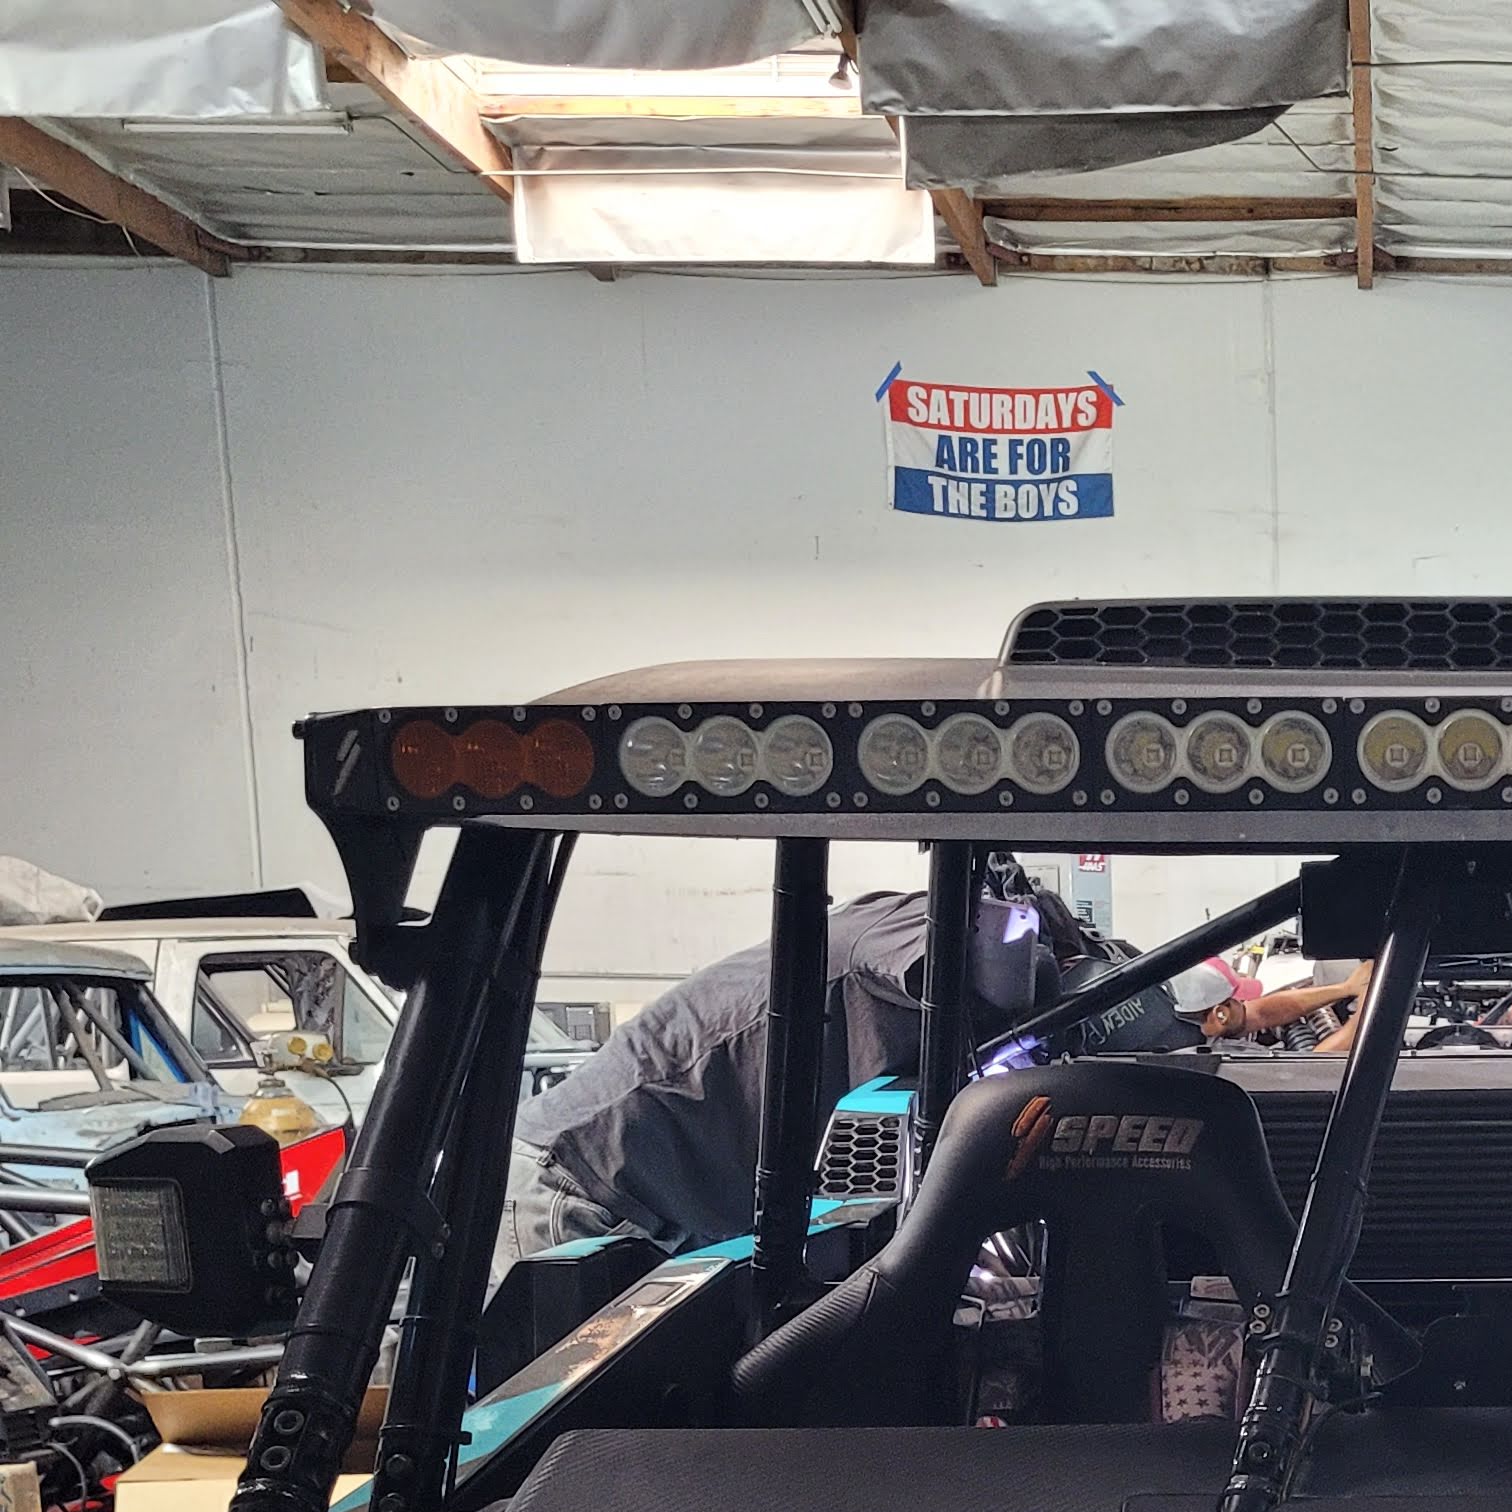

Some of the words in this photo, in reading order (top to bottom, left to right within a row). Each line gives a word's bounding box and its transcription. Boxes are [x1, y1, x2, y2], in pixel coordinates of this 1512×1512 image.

[906, 385, 1098, 430] SATURDAYS
[935, 434, 999, 475] ARE
[1008, 437, 1071, 476] FOR
[927, 475, 987, 517] THE
[994, 480, 1079, 519] BOYS
[1101, 998, 1145, 1036] AIDEN
[1050, 1115, 1204, 1154] SPEED
[1132, 1156, 1192, 1170] Accessories
